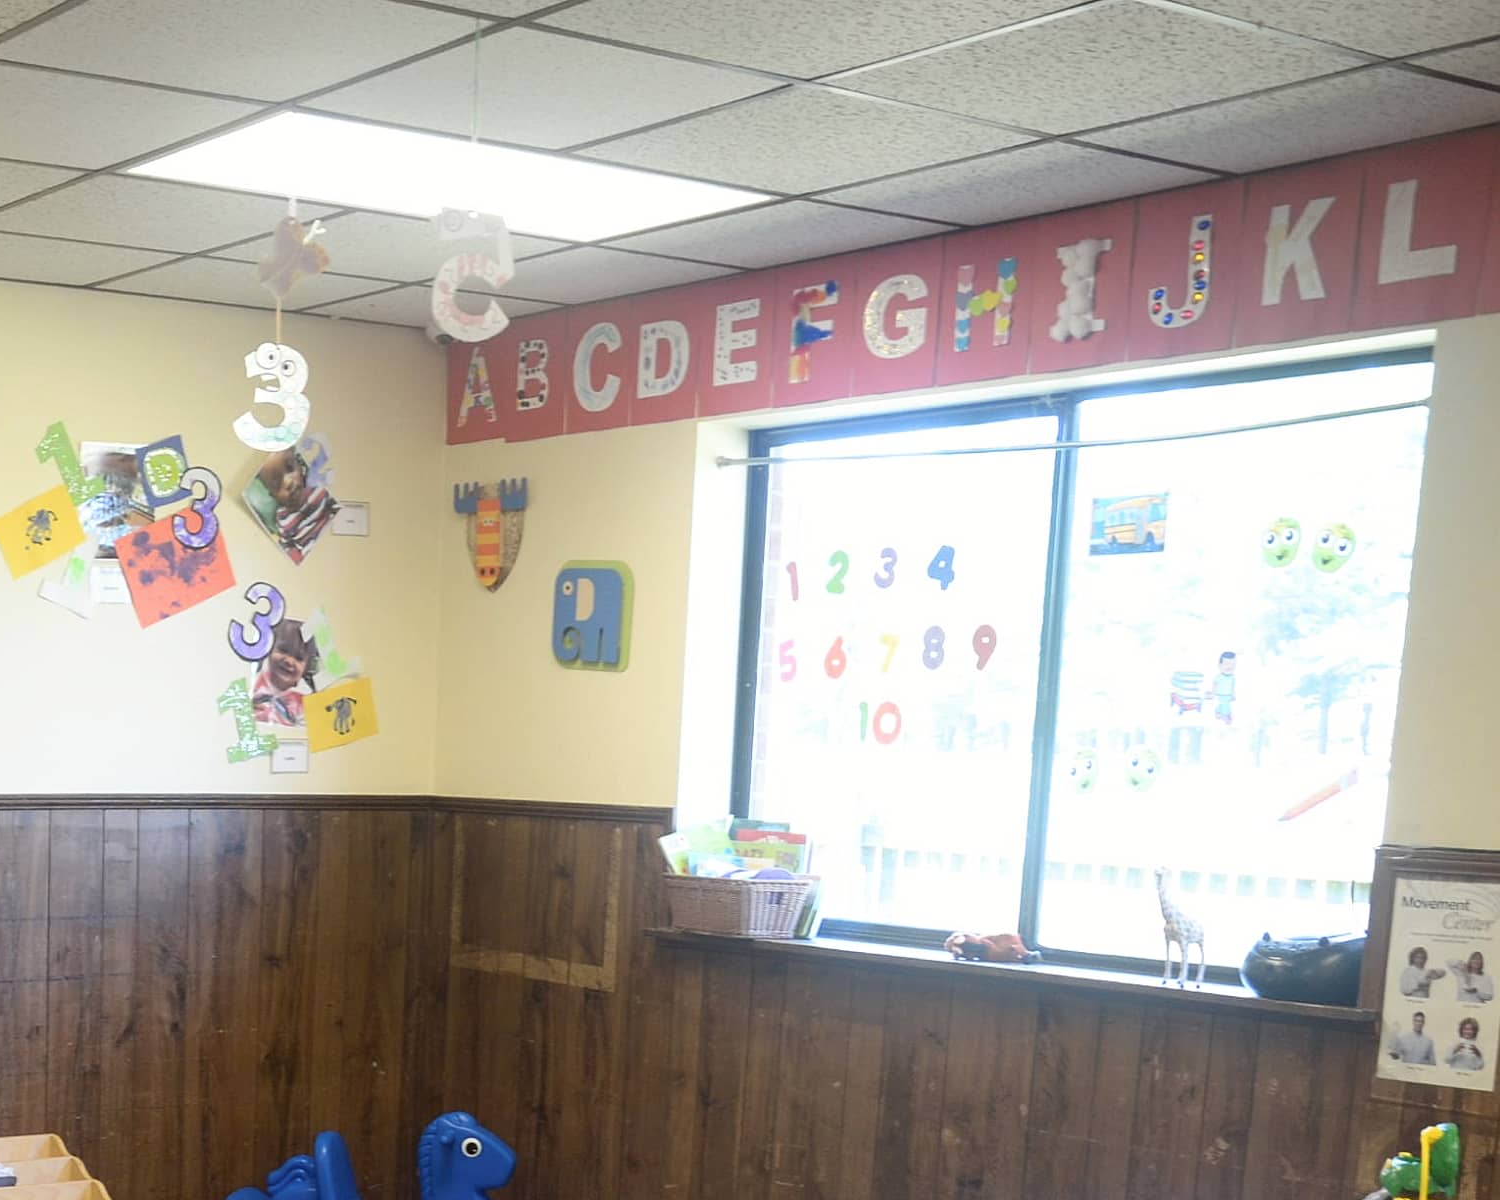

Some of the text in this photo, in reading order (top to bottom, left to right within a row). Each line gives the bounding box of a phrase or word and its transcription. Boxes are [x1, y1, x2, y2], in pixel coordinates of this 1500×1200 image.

[456, 179, 1458, 427] A B C D E F G H I J K L
[233, 342, 311, 453] 3
[172, 466, 223, 550] 3
[786, 545, 955, 601] 1 2 3 4
[228, 582, 286, 662] 3
[779, 624, 997, 682] 5 6 7 8 9
[217, 677, 279, 764] 1
[859, 701, 902, 745] 10
[1401, 895, 1471, 911] Movement
[1441, 913, 1496, 932] Center
